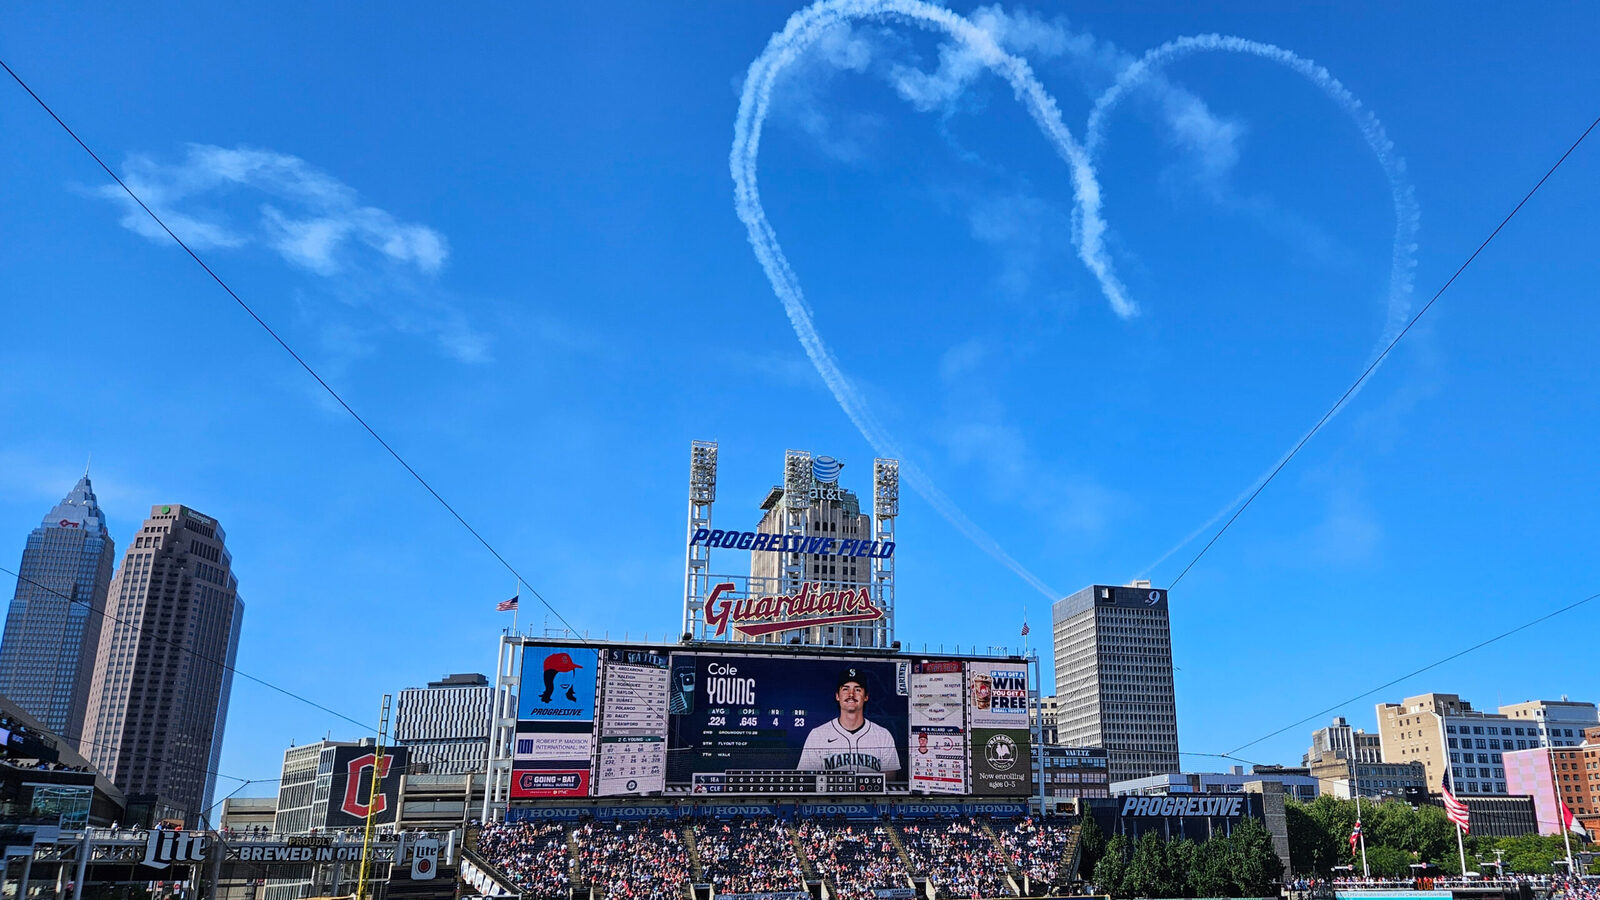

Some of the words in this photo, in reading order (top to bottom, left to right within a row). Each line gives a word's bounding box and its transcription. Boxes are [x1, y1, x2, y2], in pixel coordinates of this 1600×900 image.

[809, 488, 843, 500] at&t
[690, 528, 836, 555] PROGRESSIVE
[838, 539, 896, 558] FIELD
[704, 582, 883, 638] Guardians
[708, 663, 738, 675] Cole
[992, 678, 1026, 690] WIN
[706, 677, 756, 704] YOUNG
[992, 696, 1026, 708] FREE
[531, 708, 584, 716] PROGRESSIVE
[708, 717, 726, 726] .224
[740, 717, 758, 726] .645
[772, 718, 778, 726] 4
[794, 718, 804, 726] 23
[824, 753, 882, 772] MARINERS
[995, 772, 1024, 780] enrolling
[341, 753, 394, 818] C
[612, 808, 672, 816] HONDA
[716, 806, 772, 816] HONDA
[816, 806, 868, 814] HONDA
[910, 805, 960, 813] HONDA
[974, 804, 1024, 812] HONDA
[1122, 797, 1243, 816] PROGRESSIVE
[530, 808, 590, 817] HONDA
[288, 837, 334, 846] PROUDLY
[140, 830, 211, 869] Lite
[240, 847, 314, 860] BREWED
[316, 848, 333, 860] IN
[416, 846, 436, 858] Lite
